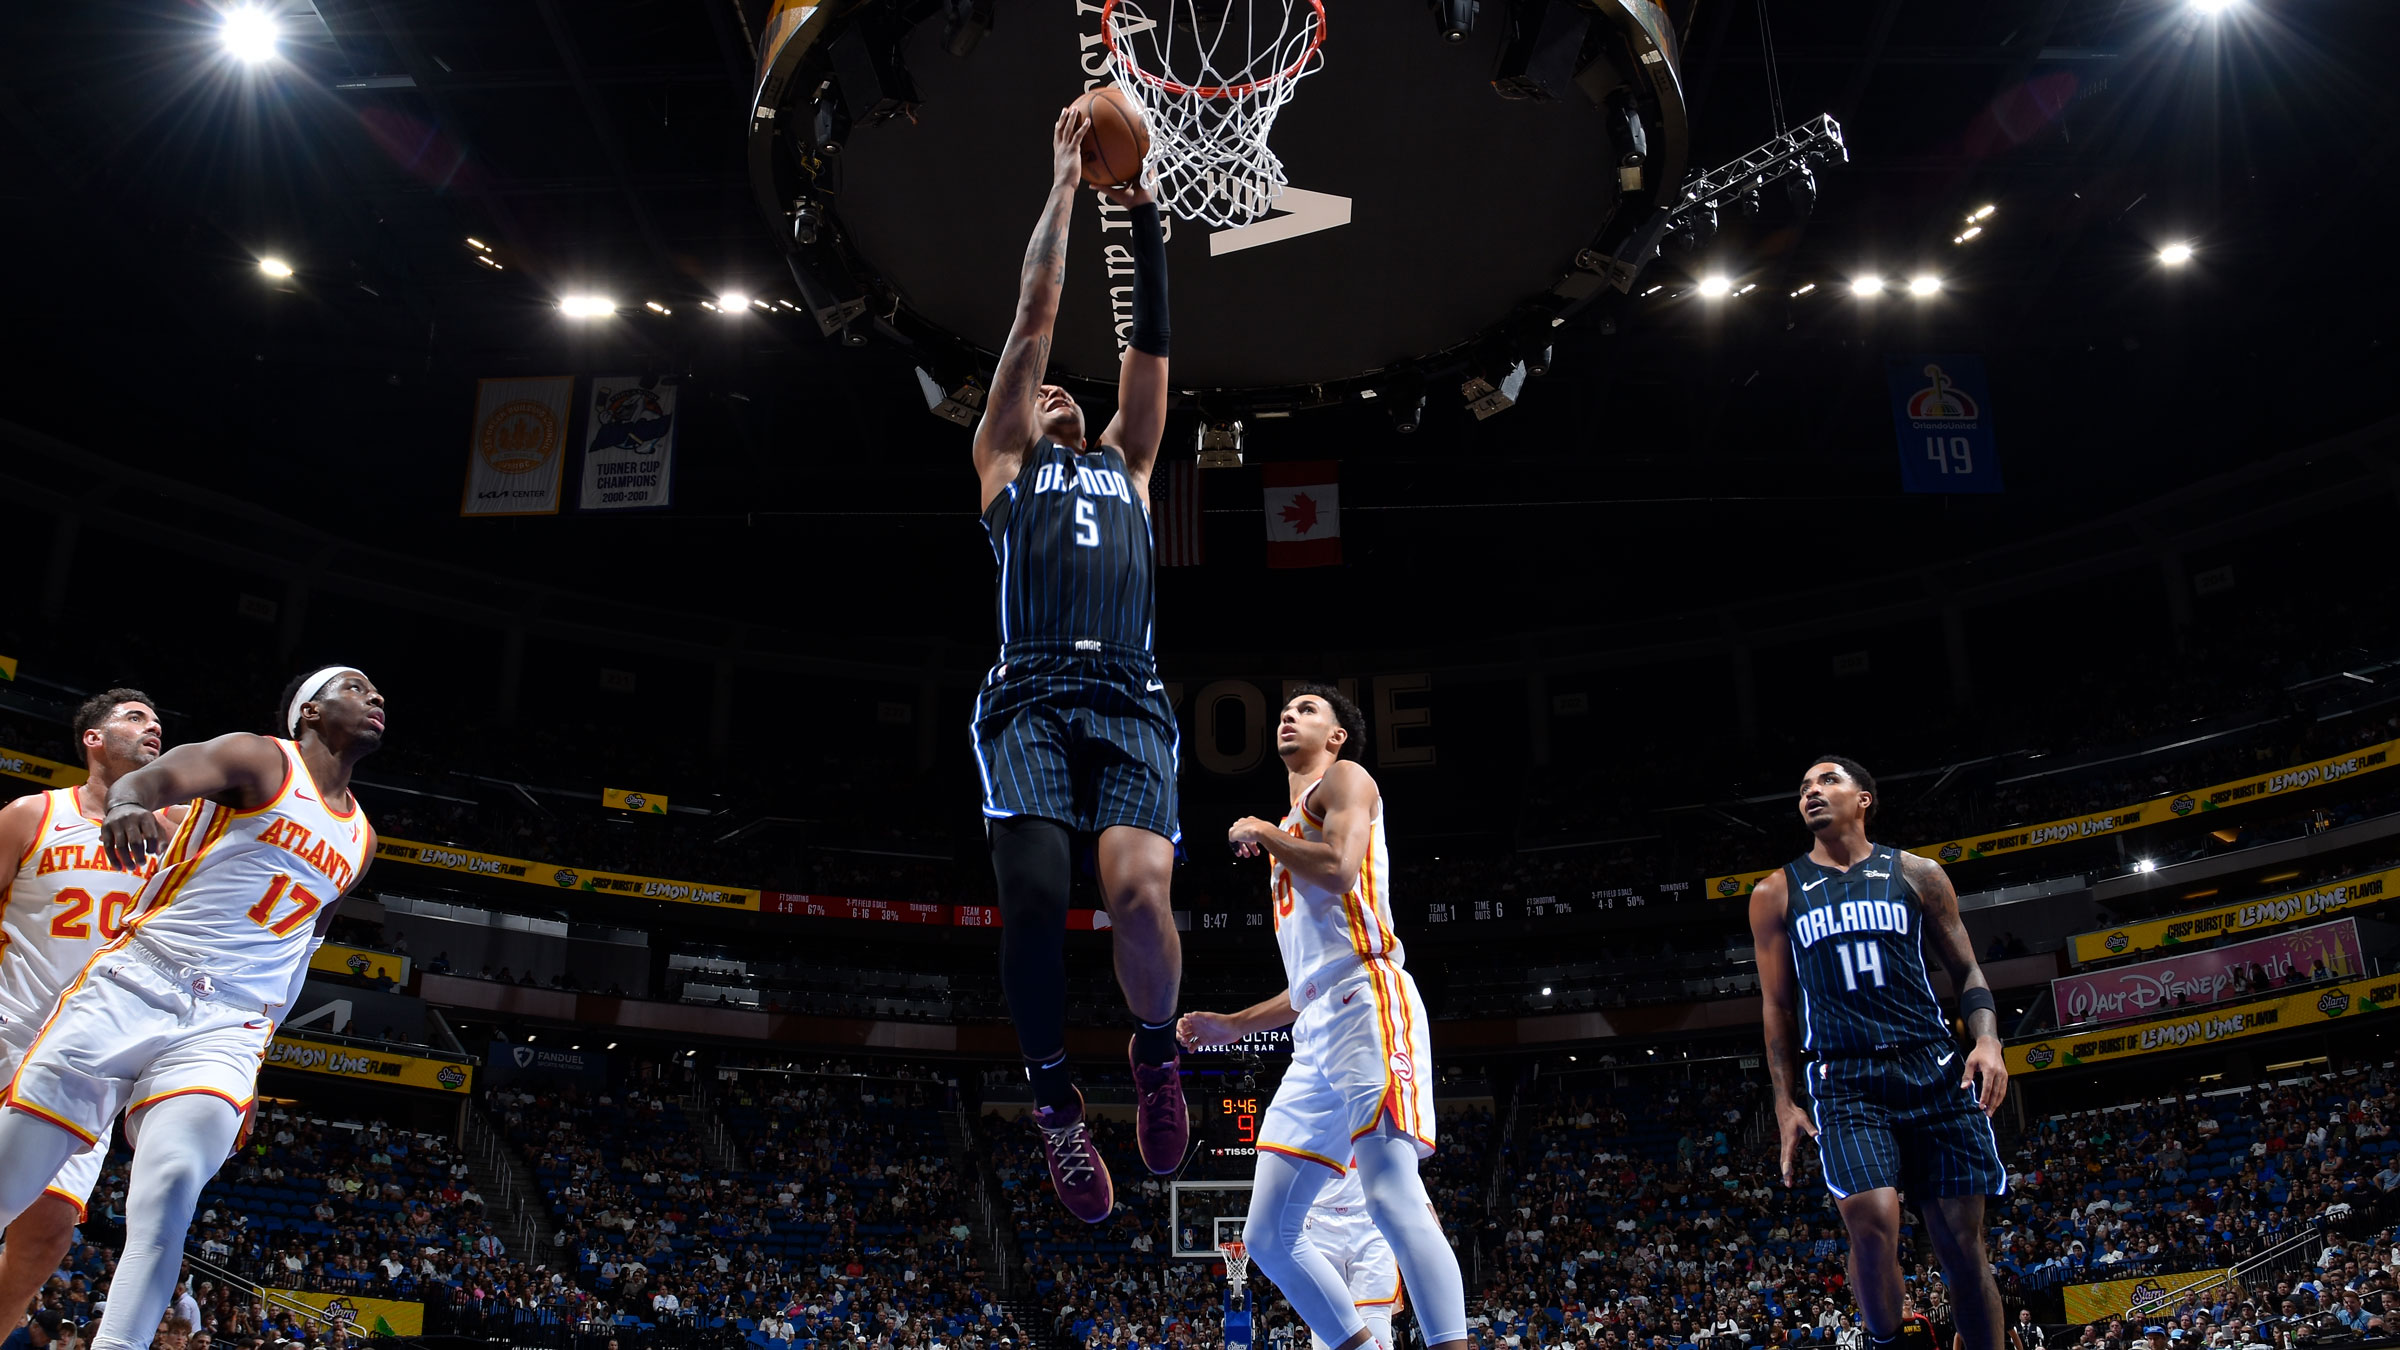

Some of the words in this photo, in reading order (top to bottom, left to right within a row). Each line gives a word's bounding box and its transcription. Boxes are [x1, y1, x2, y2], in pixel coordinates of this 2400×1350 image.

[1926, 436, 1973, 474] 49
[597, 462, 636, 475] TURNER
[639, 461, 660, 473] CUP
[597, 475, 656, 489] CHAMPIONS
[512, 490, 545, 498] CENTER
[603, 492, 648, 502] 2000-2001
[1075, 496, 1099, 547] 5
[1075, 640, 1101, 652] MAGIC
[2233, 785, 2256, 799] BURST
[2257, 782, 2267, 793] OF
[2268, 766, 2320, 793] LEMON
[2358, 751, 2386, 769] FLAVOR
[2030, 822, 2078, 845] LEMON
[419, 848, 467, 867] LEMON
[643, 882, 689, 900] LEMON
[50, 887, 131, 940] 20
[246, 873, 322, 938] 17
[1429, 903, 1446, 913] TEAM
[1450, 904, 1456, 920] 1
[1474, 900, 1490, 910] TIME
[1496, 902, 1503, 917] 6
[2167, 920, 2193, 938] CRISP
[2194, 916, 2223, 933] BURST
[2224, 913, 2236, 927] OF
[2238, 895, 2302, 928] LEMON
[2348, 880, 2383, 900] FLAVOR
[961, 916, 981, 926] FOULS
[963, 906, 980, 916] TEAM
[984, 909, 992, 925] 3
[1203, 914, 1228, 929] 9:47
[1246, 914, 1263, 926] 2ND
[1428, 913, 1448, 923] FOULS
[1474, 910, 1491, 920] OUTS
[1796, 900, 1908, 949] ORLANDO
[2104, 933, 2129, 948] Starry
[1836, 940, 1886, 993] 14
[2370, 984, 2396, 1003] CRISP
[2318, 994, 2349, 1011] Starry
[2073, 1041, 2098, 1058] CRISP
[2099, 1038, 2126, 1053] BURST
[2127, 1035, 2138, 1049] OF
[2140, 1020, 2202, 1050] LEMON
[2246, 1009, 2278, 1028] FLAVOR
[265, 1042, 327, 1067] LEMON
[1197, 1044, 1249, 1052] BASELINE
[1254, 1044, 1275, 1052] BAR
[2026, 1045, 2055, 1064] Starry
[537, 1051, 584, 1065] FANDUEL
[437, 1067, 466, 1086] Starry
[1222, 1098, 1257, 1114] 9:46
[1237, 1114, 1255, 1142] 9
[1224, 1148, 1260, 1156] TISSO
